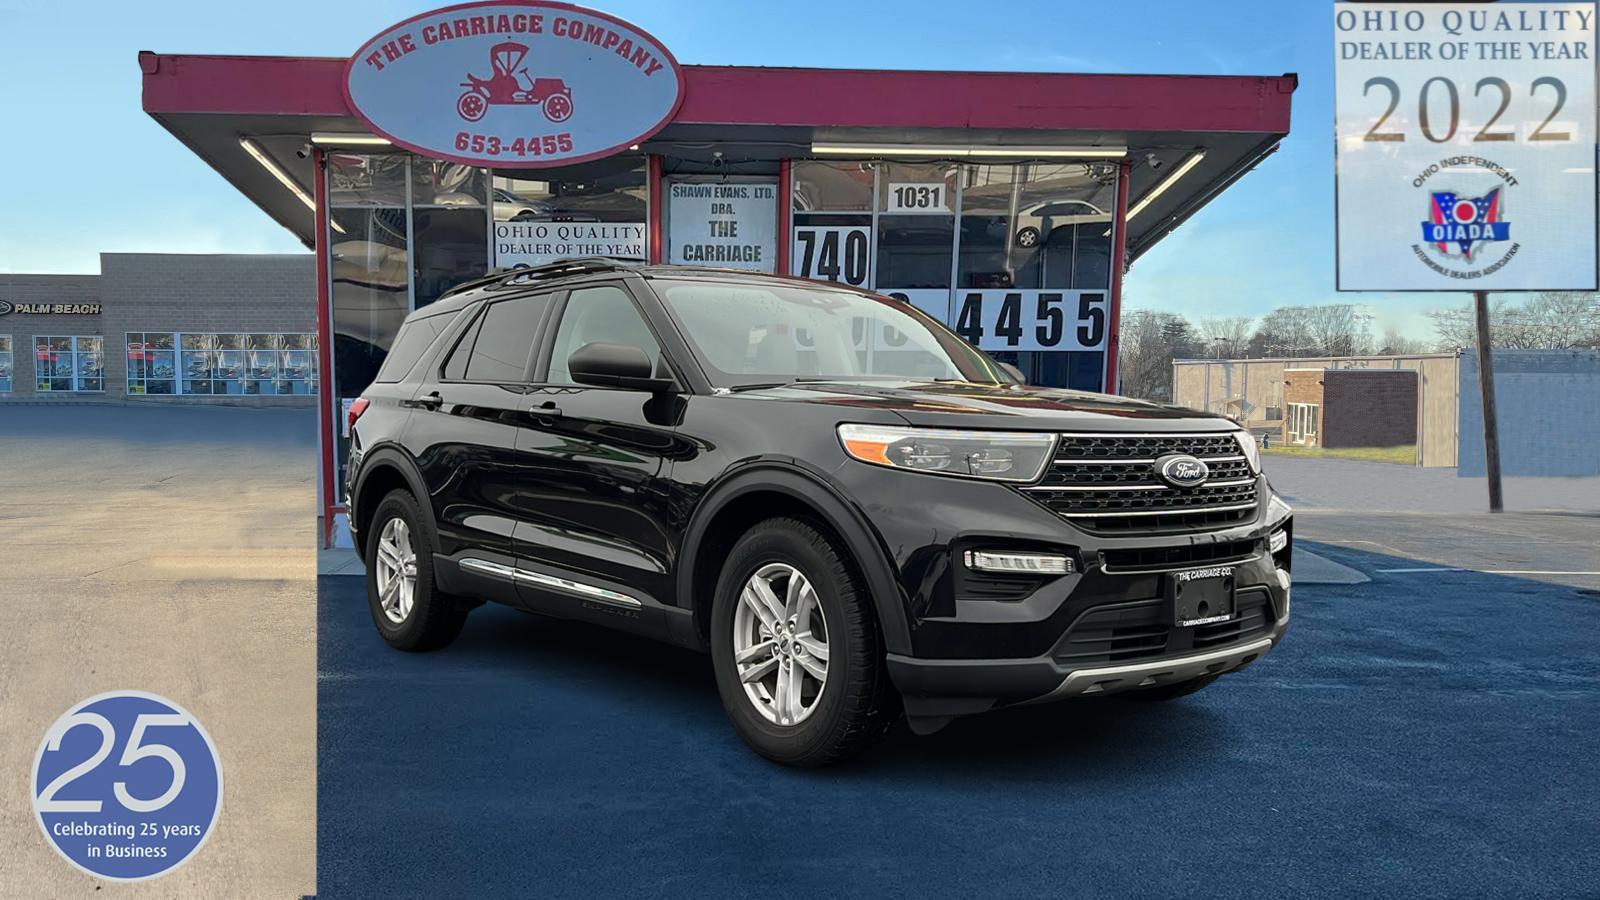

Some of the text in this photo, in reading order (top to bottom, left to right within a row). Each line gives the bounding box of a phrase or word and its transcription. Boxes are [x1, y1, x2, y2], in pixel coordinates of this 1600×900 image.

[1336, 10, 1593, 35] OHIO QUALITY
[365, 14, 664, 77] THE CARRIAGE COMPANY
[1340, 42, 1589, 60] DEALER OF THE YEAR
[1363, 76, 1571, 143] 2022
[455, 132, 573, 157] 653-4455
[1413, 155, 1519, 188] OHIO INDEPENDENT
[673, 186, 712, 198] SHAWN
[754, 188, 775, 199] LTD.
[894, 187, 941, 208] 1031
[711, 203, 735, 215] DBA.
[497, 226, 644, 241] OHIO QUALITY
[708, 220, 738, 237] THE
[1432, 224, 1495, 240] OIADA
[499, 243, 641, 255] DEALER OF THE YEAR
[683, 244, 762, 262] CARRIAGE
[796, 230, 868, 286] 740
[1411, 242, 1521, 279] AUTOMOBILE DEALERS ASSOCIATION
[14, 303, 51, 314] PALM
[956, 293, 1105, 347] 4455
[1175, 462, 1200, 478] Ford
